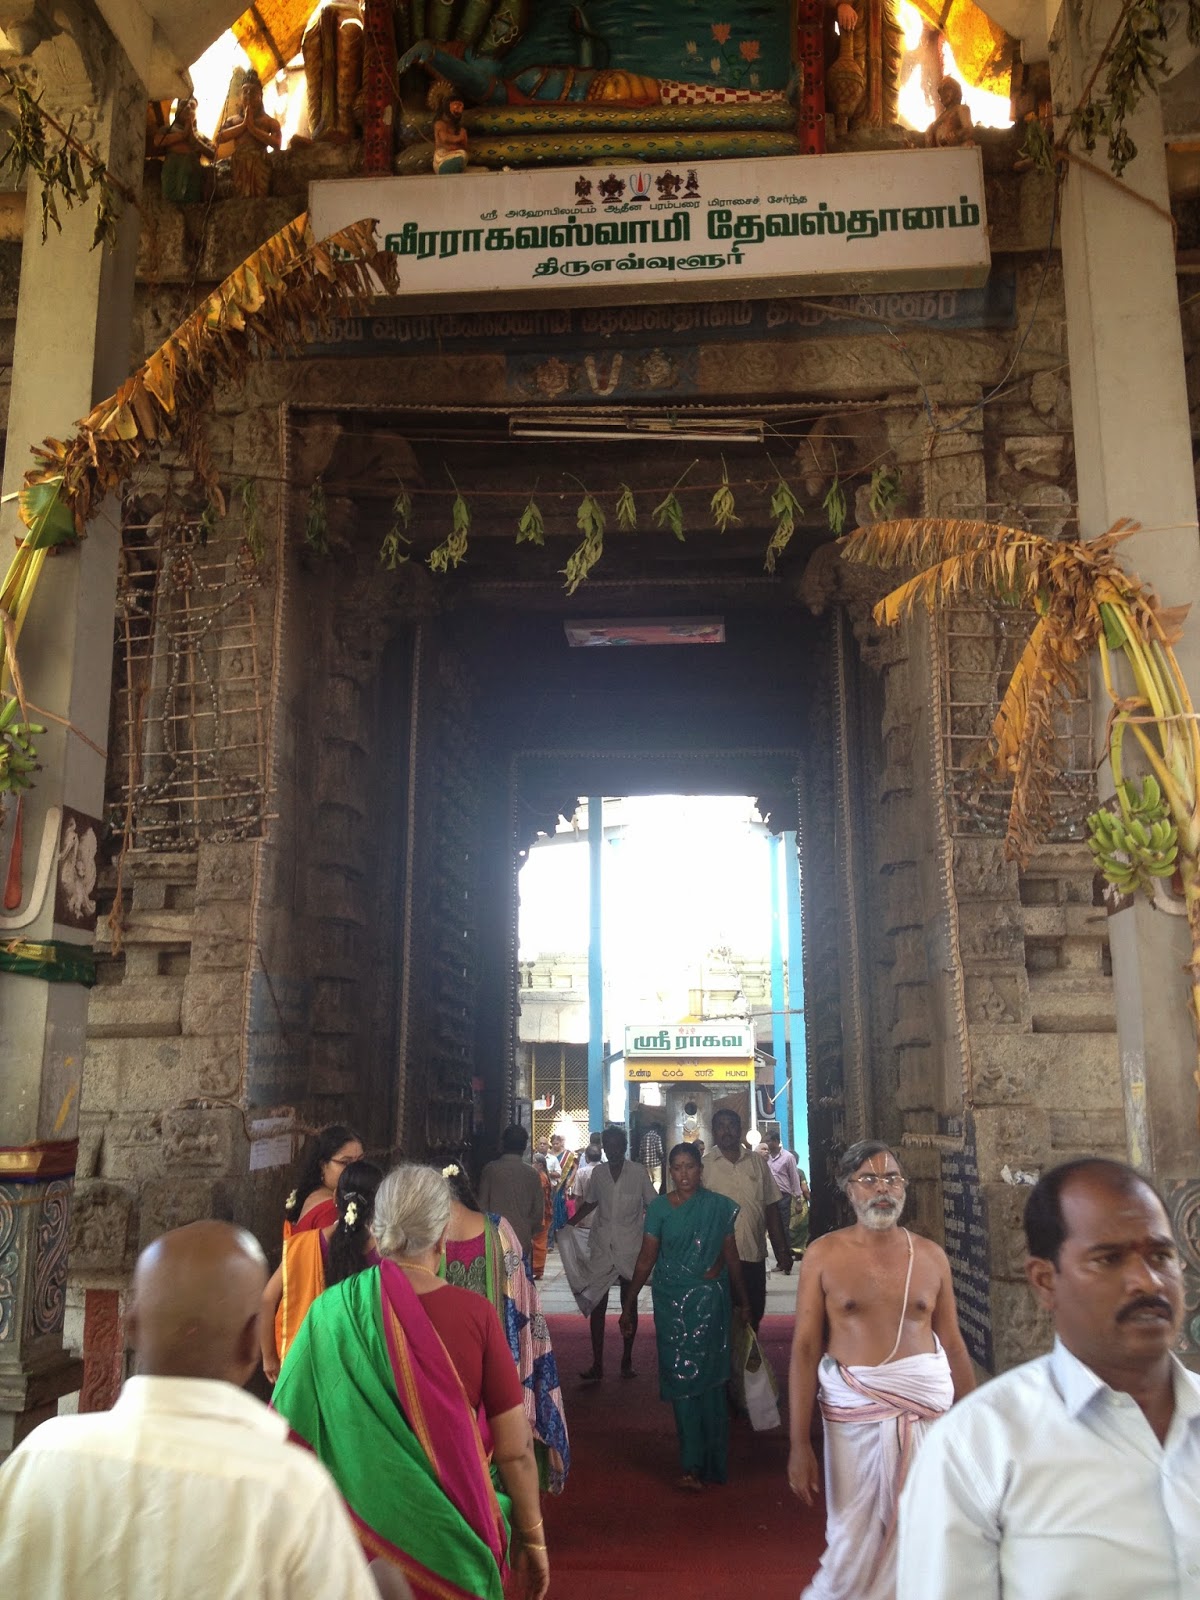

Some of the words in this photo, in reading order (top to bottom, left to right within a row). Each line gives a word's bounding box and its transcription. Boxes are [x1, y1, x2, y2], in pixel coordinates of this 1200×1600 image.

[650, 200, 700, 211] பரம்பரை
[385, 211, 690, 260] வீரராகவஸ்வாமி
[707, 195, 980, 247] தேவஸ்தானம்
[634, 1030, 670, 1050] ஸ்ரீ
[675, 1035, 742, 1050] ராகவ
